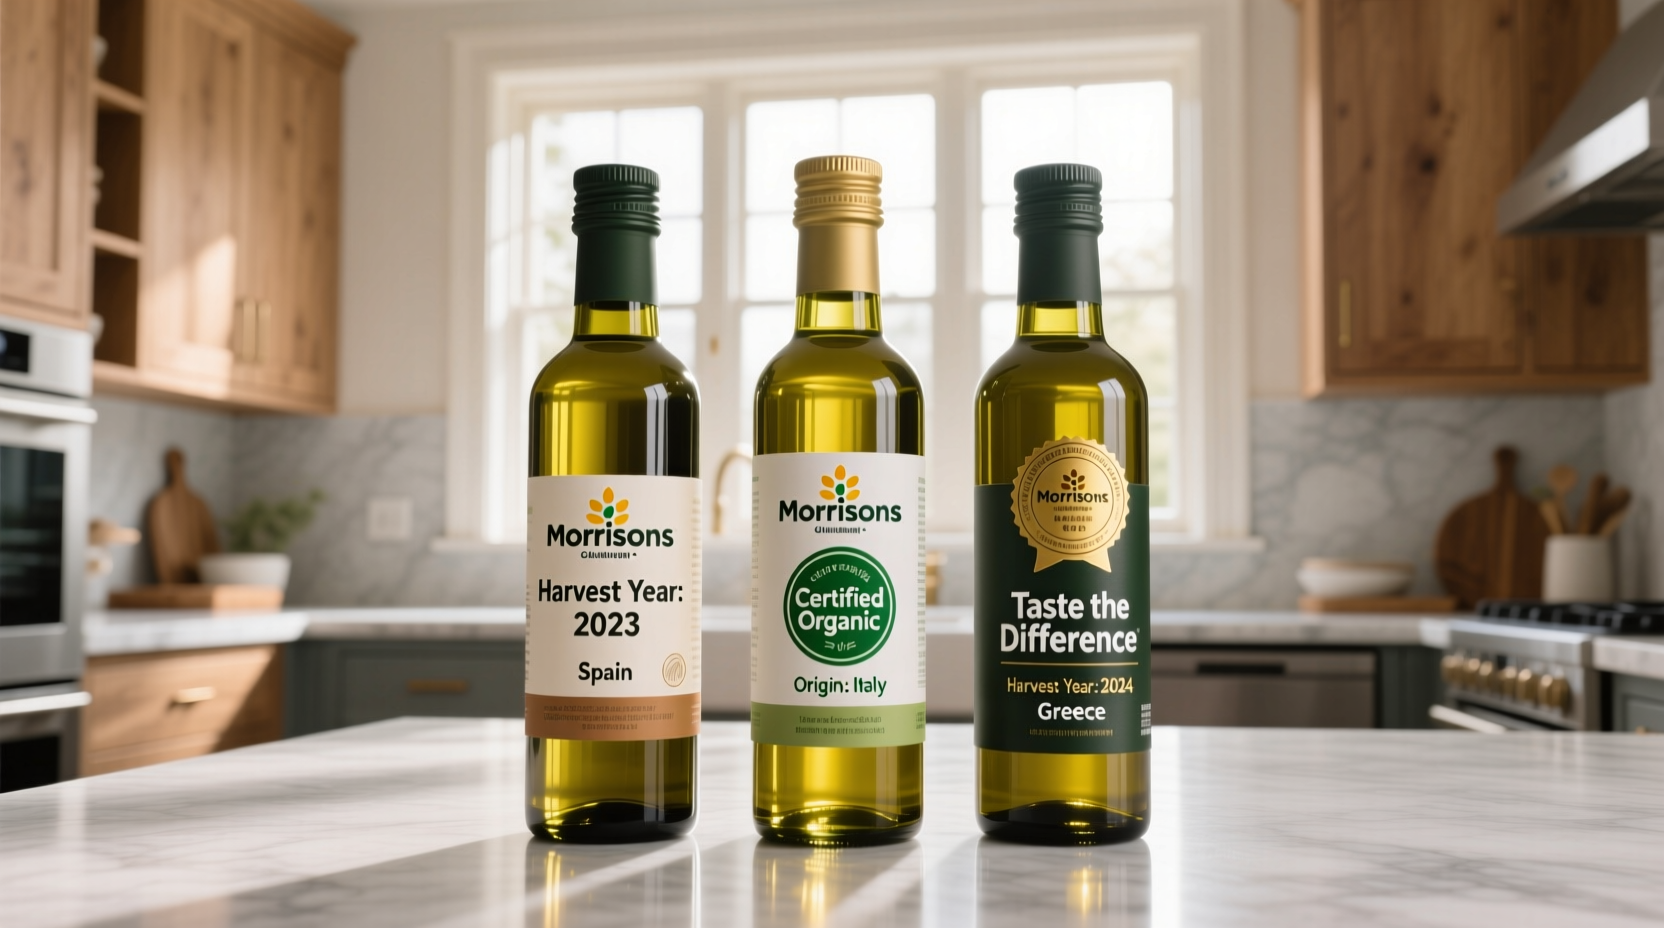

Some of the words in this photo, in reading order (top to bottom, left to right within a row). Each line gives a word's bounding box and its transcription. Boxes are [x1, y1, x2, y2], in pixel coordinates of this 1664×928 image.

[1037, 487, 1109, 503] Morrisons
[779, 496, 902, 522] Morrisons
[547, 521, 674, 547] Morrisons
[538, 579, 621, 602] Harvest
[627, 579, 683, 602] Year:
[795, 586, 884, 608] Certified
[1011, 591, 1085, 619] Taste
[1090, 591, 1130, 619] the
[573, 611, 640, 637] 2023
[798, 610, 881, 637] Organic
[1000, 623, 1138, 653] Difference
[578, 661, 633, 686] Spain
[793, 676, 850, 698] Origin:
[853, 676, 887, 698] Italy
[1037, 702, 1106, 720] Greece
